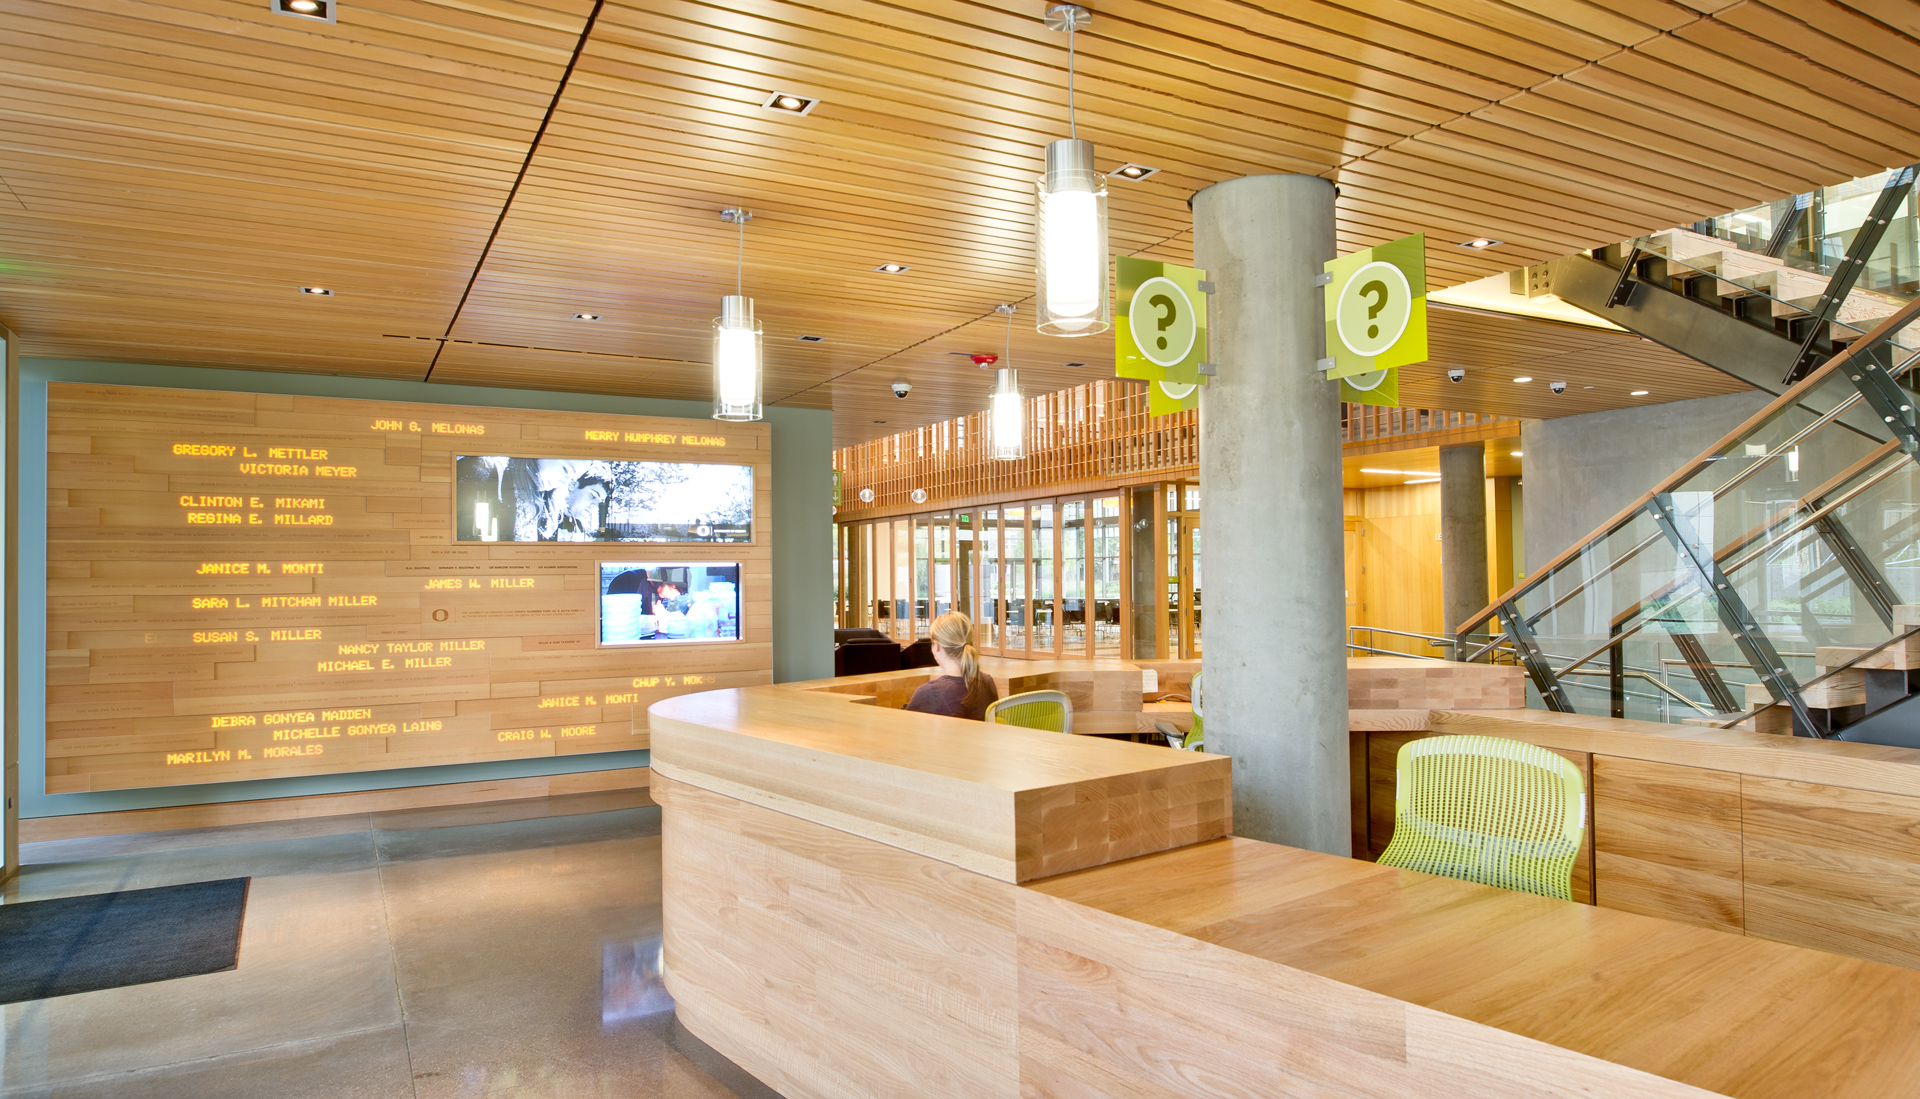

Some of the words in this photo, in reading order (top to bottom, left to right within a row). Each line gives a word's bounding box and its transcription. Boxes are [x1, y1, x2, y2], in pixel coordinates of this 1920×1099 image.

[371, 420, 403, 431] JOHN
[409, 421, 422, 433] G.
[432, 423, 485, 436] MELONAS
[585, 430, 620, 442] MERRY
[624, 432, 678, 445] HUMPHREY
[682, 435, 727, 448] MELONAS
[173, 444, 236, 457] GREGORY
[243, 447, 258, 458] L.
[269, 448, 329, 461] METTLER
[240, 463, 309, 476] VICTORIA
[315, 466, 358, 478] MEYER
[180, 496, 243, 508] CLINTON
[250, 497, 264, 509] E.
[276, 498, 325, 510] MIKAMI
[187, 513, 242, 525] REGINA
[249, 514, 263, 525] E.
[274, 514, 334, 526] MILLARD
[196, 563, 250, 575] JANICE
[257, 563, 271, 575] M.
[282, 563, 325, 575] MONTI
[425, 579, 463, 590] JAMES
[469, 579, 482, 589] W.
[491, 578, 535, 589] MILLER
[192, 598, 229, 609] SARA
[236, 598, 251, 609] L.
[262, 597, 322, 608] MITCHAM
[328, 596, 378, 607] MILLER
[193, 632, 238, 644] SUSAN
[245, 631, 260, 642] S.
[271, 629, 322, 641] MILLER
[339, 644, 380, 655] NANCY
[387, 642, 434, 654] TAYLOR
[440, 640, 486, 652] MILLER
[318, 660, 375, 673] MICHAEL
[382, 659, 395, 670] E.
[405, 657, 452, 669] MILLER
[632, 677, 660, 689] CHUP
[665, 677, 676, 687] Y.
[538, 696, 580, 709] JANICE
[585, 696, 597, 706] M.
[606, 694, 639, 705] MONTI
[211, 716, 257, 729] DEBRA
[263, 712, 316, 726] GONYEA
[322, 709, 372, 722] MADDEN
[273, 726, 341, 741] MICHELLE
[348, 724, 397, 737] GONYEA
[403, 721, 443, 733] LAING
[498, 730, 535, 742] CRAIG
[540, 729, 552, 739] W.
[561, 726, 597, 738] MOORE
[167, 751, 231, 765] MARILYN
[238, 750, 252, 760] M.
[264, 744, 324, 759] MORALES
